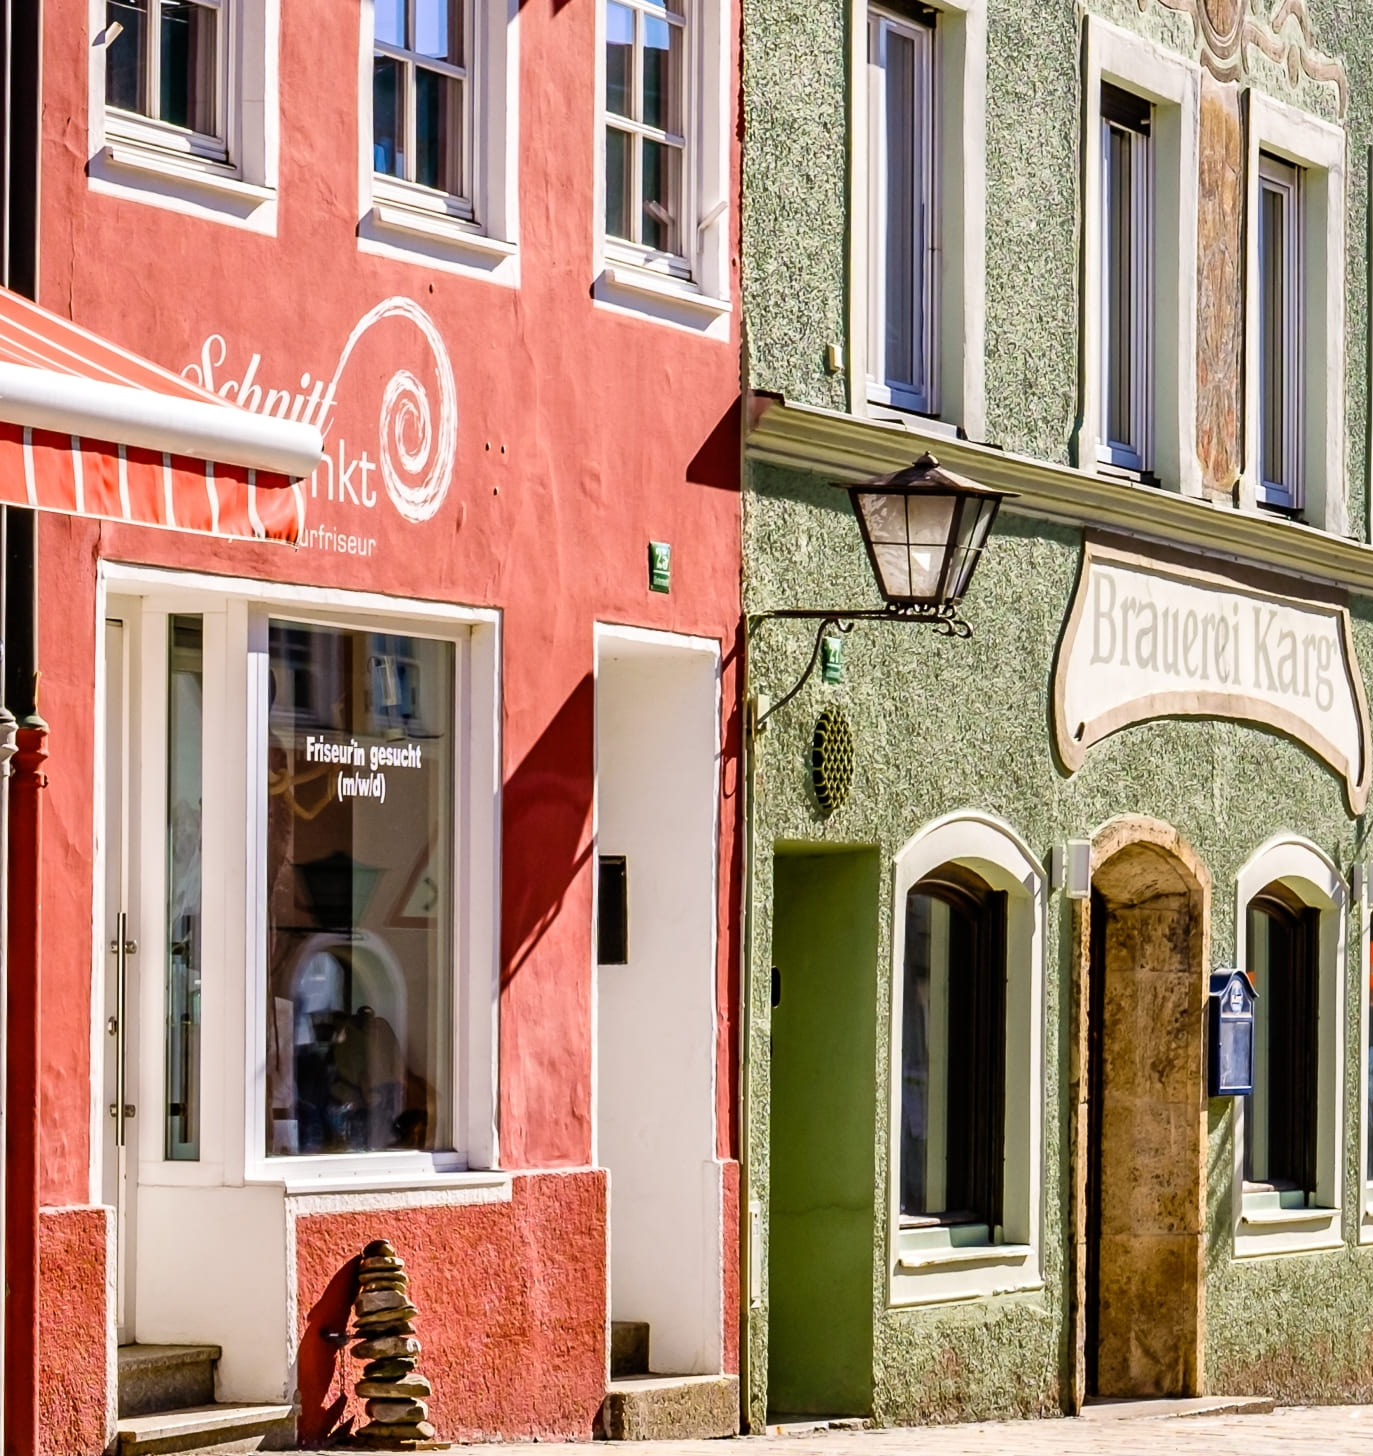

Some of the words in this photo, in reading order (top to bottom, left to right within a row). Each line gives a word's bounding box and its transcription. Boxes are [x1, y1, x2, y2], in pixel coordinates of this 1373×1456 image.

[1090, 570, 1242, 686] Brauerei
[1252, 606, 1338, 713] Karg
[370, 743, 421, 771] gesucht
[337, 770, 386, 804] (m/w/d)
